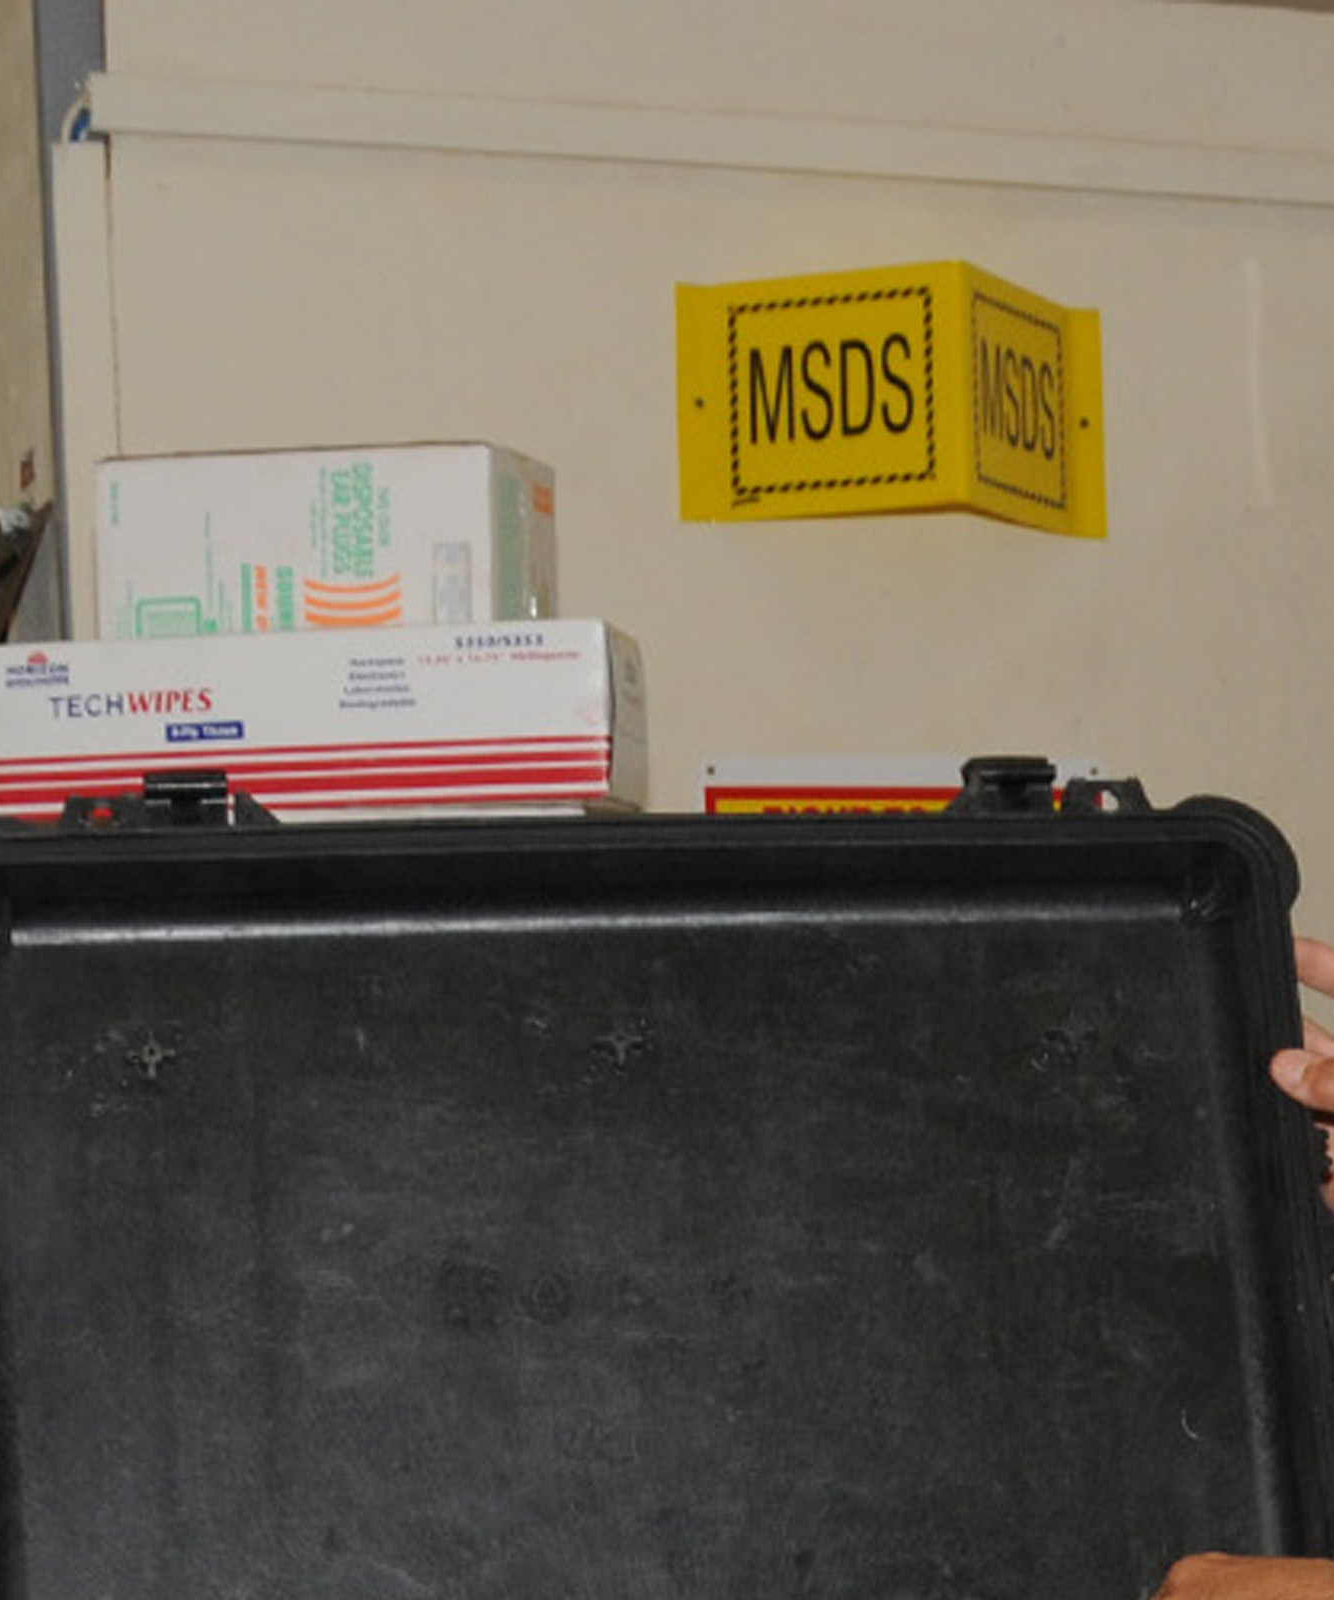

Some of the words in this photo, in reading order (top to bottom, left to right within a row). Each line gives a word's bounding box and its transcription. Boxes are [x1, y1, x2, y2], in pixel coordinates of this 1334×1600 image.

[748, 332, 915, 445] MSDS
[980, 337, 1056, 462] MSDS
[331, 469, 352, 506] EAR
[353, 463, 373, 577] DISPOSABLE
[333, 511, 353, 574] PLUGS
[48, 687, 214, 718] TECHWIPES
